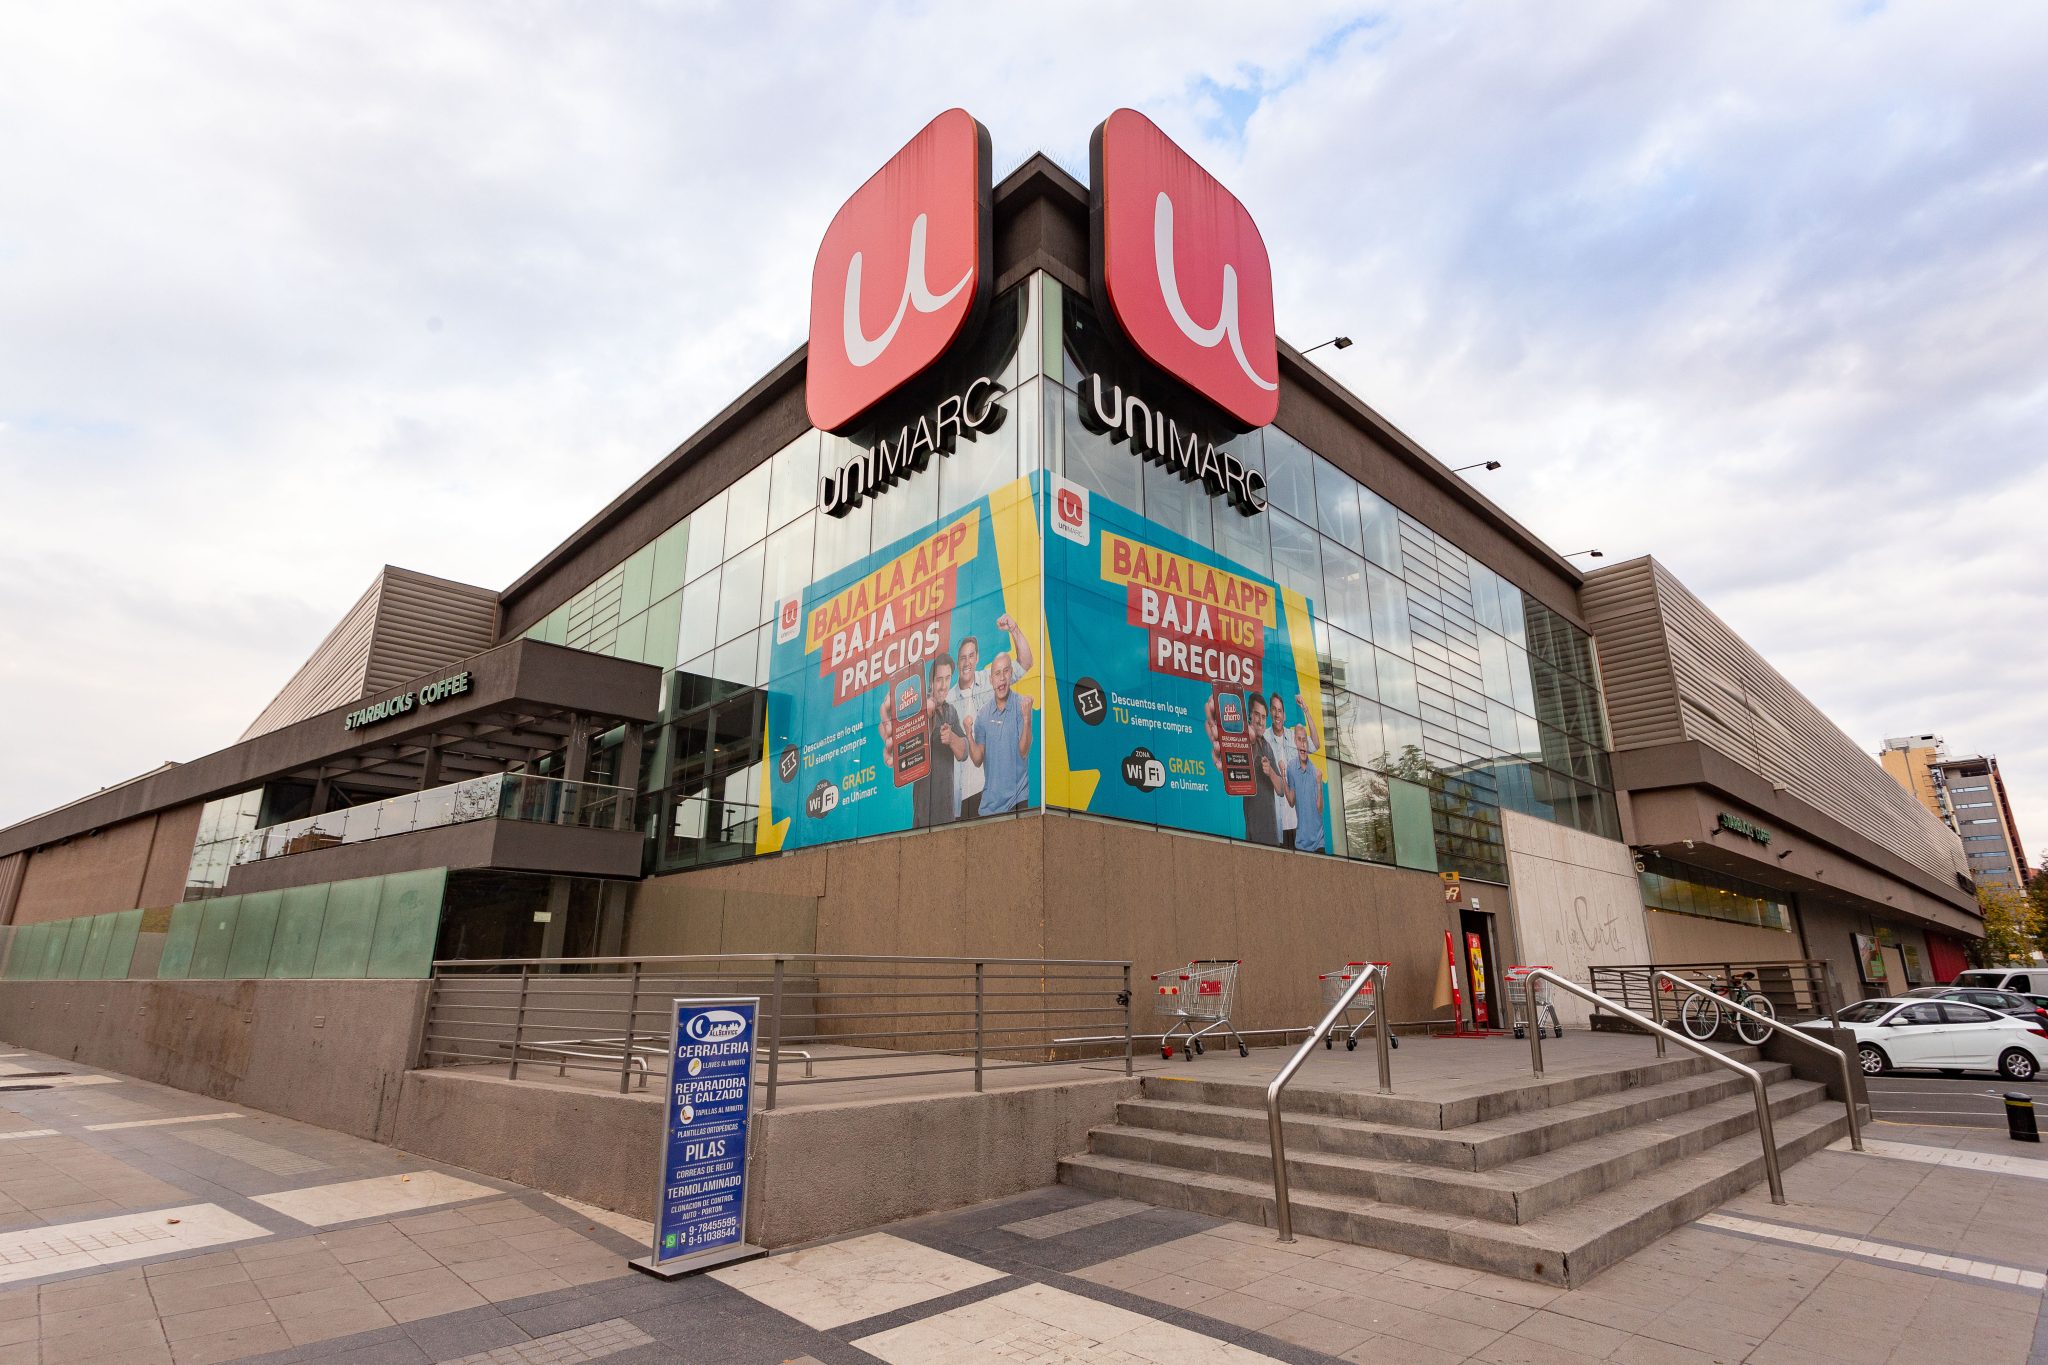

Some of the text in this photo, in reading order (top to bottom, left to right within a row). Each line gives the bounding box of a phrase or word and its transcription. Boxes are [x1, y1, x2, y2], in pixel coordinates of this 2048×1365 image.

[813, 522, 967, 641] BAJA LA APP
[1113, 538, 1268, 616] BAJA LA APP
[831, 577, 945, 668] BAJA TUS
[1141, 587, 1255, 648] BAJA TUS
[841, 621, 940, 698] PRECIOS
[1157, 636, 1255, 686] PRECIOS
[344, 671, 468, 731] STARBUCKS COFFEE
[1112, 692, 1188, 717] Descuentos en lo que
[1113, 707, 1192, 735] TU siempre compras
[803, 721, 864, 755] Descuentos en lo que
[803, 736, 867, 770] TU siempre compras
[1168, 757, 1206, 776] GRATIS
[842, 765, 876, 790] GRATIS
[1170, 778, 1208, 792] en Unimarc
[842, 786, 878, 805] en Unimarc
[678, 1042, 749, 1058] CERRAJERIA
[676, 1077, 746, 1094] REPARADORA
[678, 1088, 743, 1105] DE CALZADO
[695, 1108, 717, 1116] TAPILLAS
[678, 1128, 706, 1138] PLANTILLAS
[685, 1140, 726, 1161] PILAS
[676, 1161, 734, 1180] CORREAS DE RELOJ
[668, 1175, 742, 1199] TERMOLAMINADO
[711, 1194, 734, 1205] CONTROL
[682, 1212, 696, 1220] AUTO
[689, 1217, 736, 1235] 9-78455595
[688, 1227, 736, 1246] 9-51038544
